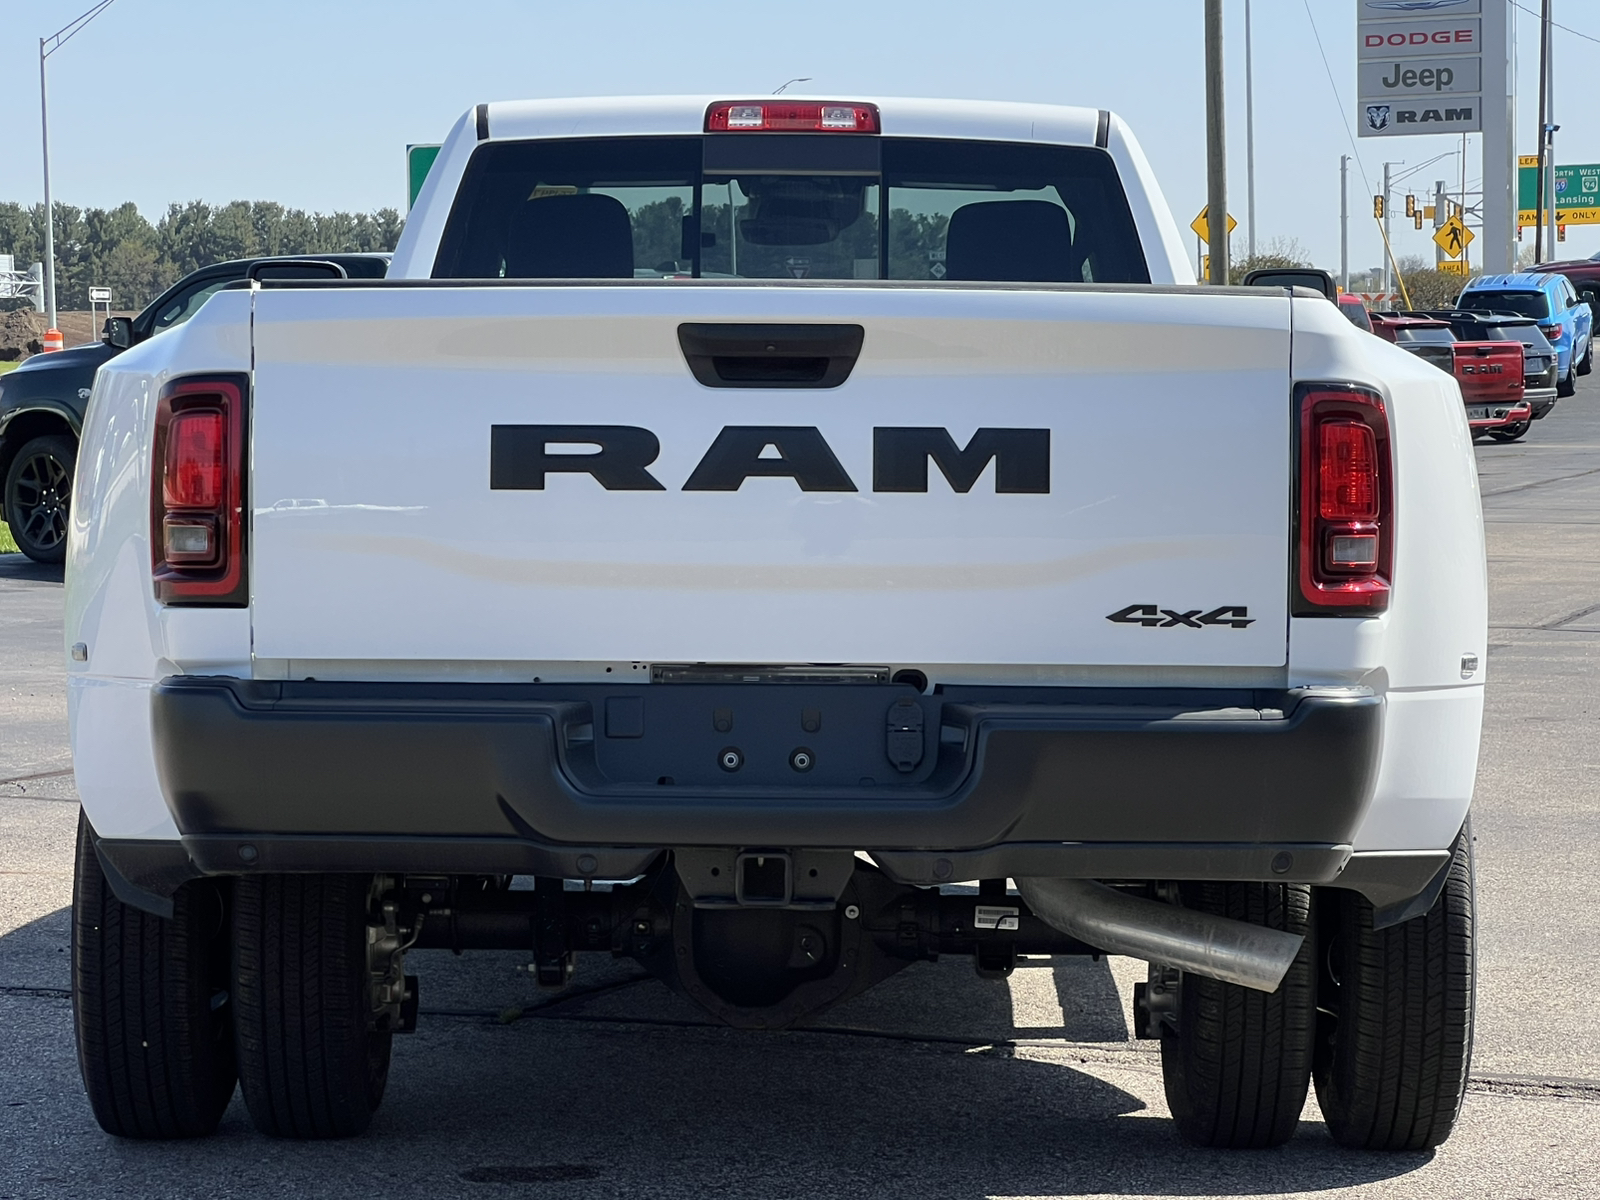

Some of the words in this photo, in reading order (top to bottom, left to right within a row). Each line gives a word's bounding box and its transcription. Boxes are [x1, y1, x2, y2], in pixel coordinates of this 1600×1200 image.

[1365, 30, 1473, 47] DODGE
[1382, 64, 1454, 91] Jeep
[1397, 108, 1473, 123] RAM
[1556, 181, 1566, 190] 69
[1555, 195, 1594, 204] Lansing
[1462, 364, 1503, 375] RAM
[491, 424, 1050, 493] RAM
[1105, 604, 1256, 628] 4x4
